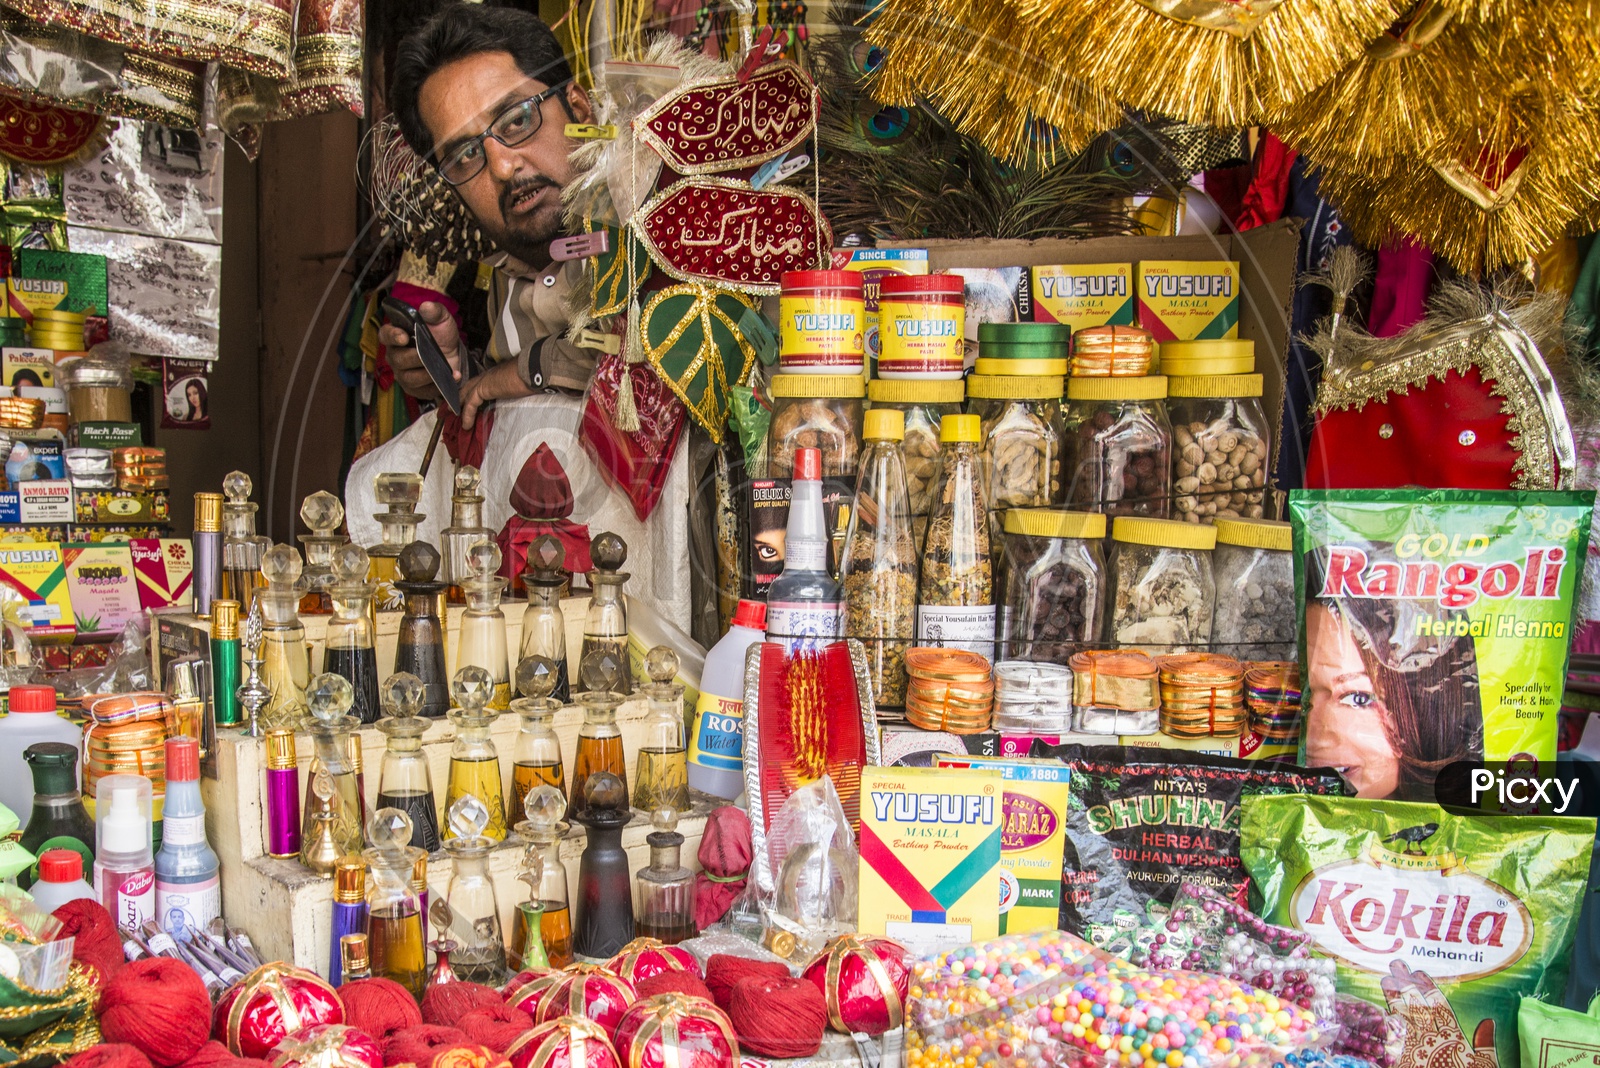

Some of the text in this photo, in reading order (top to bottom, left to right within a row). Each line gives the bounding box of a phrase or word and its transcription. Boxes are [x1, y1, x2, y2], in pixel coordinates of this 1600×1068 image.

[859, 250, 920, 260] SINCE 1880
[13, 279, 66, 294] YUSUFI
[1019, 270, 1029, 315] CHIKSA
[1040, 276, 1126, 298] YUSUFI
[1145, 275, 1232, 298] YUSUFI
[1065, 300, 1104, 308] MASALA
[1168, 300, 1208, 308] MASALA
[1056, 309, 1111, 317] Bathing Powder
[1160, 309, 1215, 317] Bathing Powder
[794, 314, 855, 331] YUSUFI
[895, 320, 956, 336] YUSUFI
[83, 427, 134, 435] Black Rose
[33, 447, 58, 455] expert
[23, 487, 70, 496] ANMOL RATAN
[753, 488, 783, 501] DELUX
[1395, 533, 1490, 558] GOLD
[0, 550, 59, 564] YUSUFI
[1315, 545, 1568, 610] Rangoli
[923, 614, 944, 623] Special
[978, 613, 988, 622] Hair
[1414, 614, 1566, 639] Herbal Henna
[1505, 682, 1542, 694] Specially
[1500, 695, 1527, 705] Hands
[1530, 696, 1536, 705] &
[1515, 709, 1544, 721] Beauty
[705, 735, 738, 750] Water
[1242, 734, 1254, 745] NEW
[1245, 738, 1258, 751] PACK
[1030, 769, 1059, 781] 1880
[872, 782, 907, 790] SPECIAL
[1154, 780, 1207, 793] NITYA'S
[871, 792, 994, 825] YUSUFI
[1012, 798, 1035, 812] ASLI
[904, 827, 960, 838] MASALA
[892, 839, 969, 851] Bathing Powder
[1142, 832, 1215, 850] HERBAL
[1018, 858, 1052, 868] Powder
[1112, 848, 1243, 869] DULHAN MEHAND
[1381, 852, 1442, 868] NATURAL
[126, 873, 155, 894] Dabur
[1126, 871, 1228, 887] AYURVEDIC FORMULA
[1022, 888, 1054, 898] MARK
[1064, 889, 1092, 903] COOL
[1305, 879, 1508, 955] Kokila
[1410, 945, 1485, 964] Mehandi
[1567, 1052, 1589, 1065] PURE
